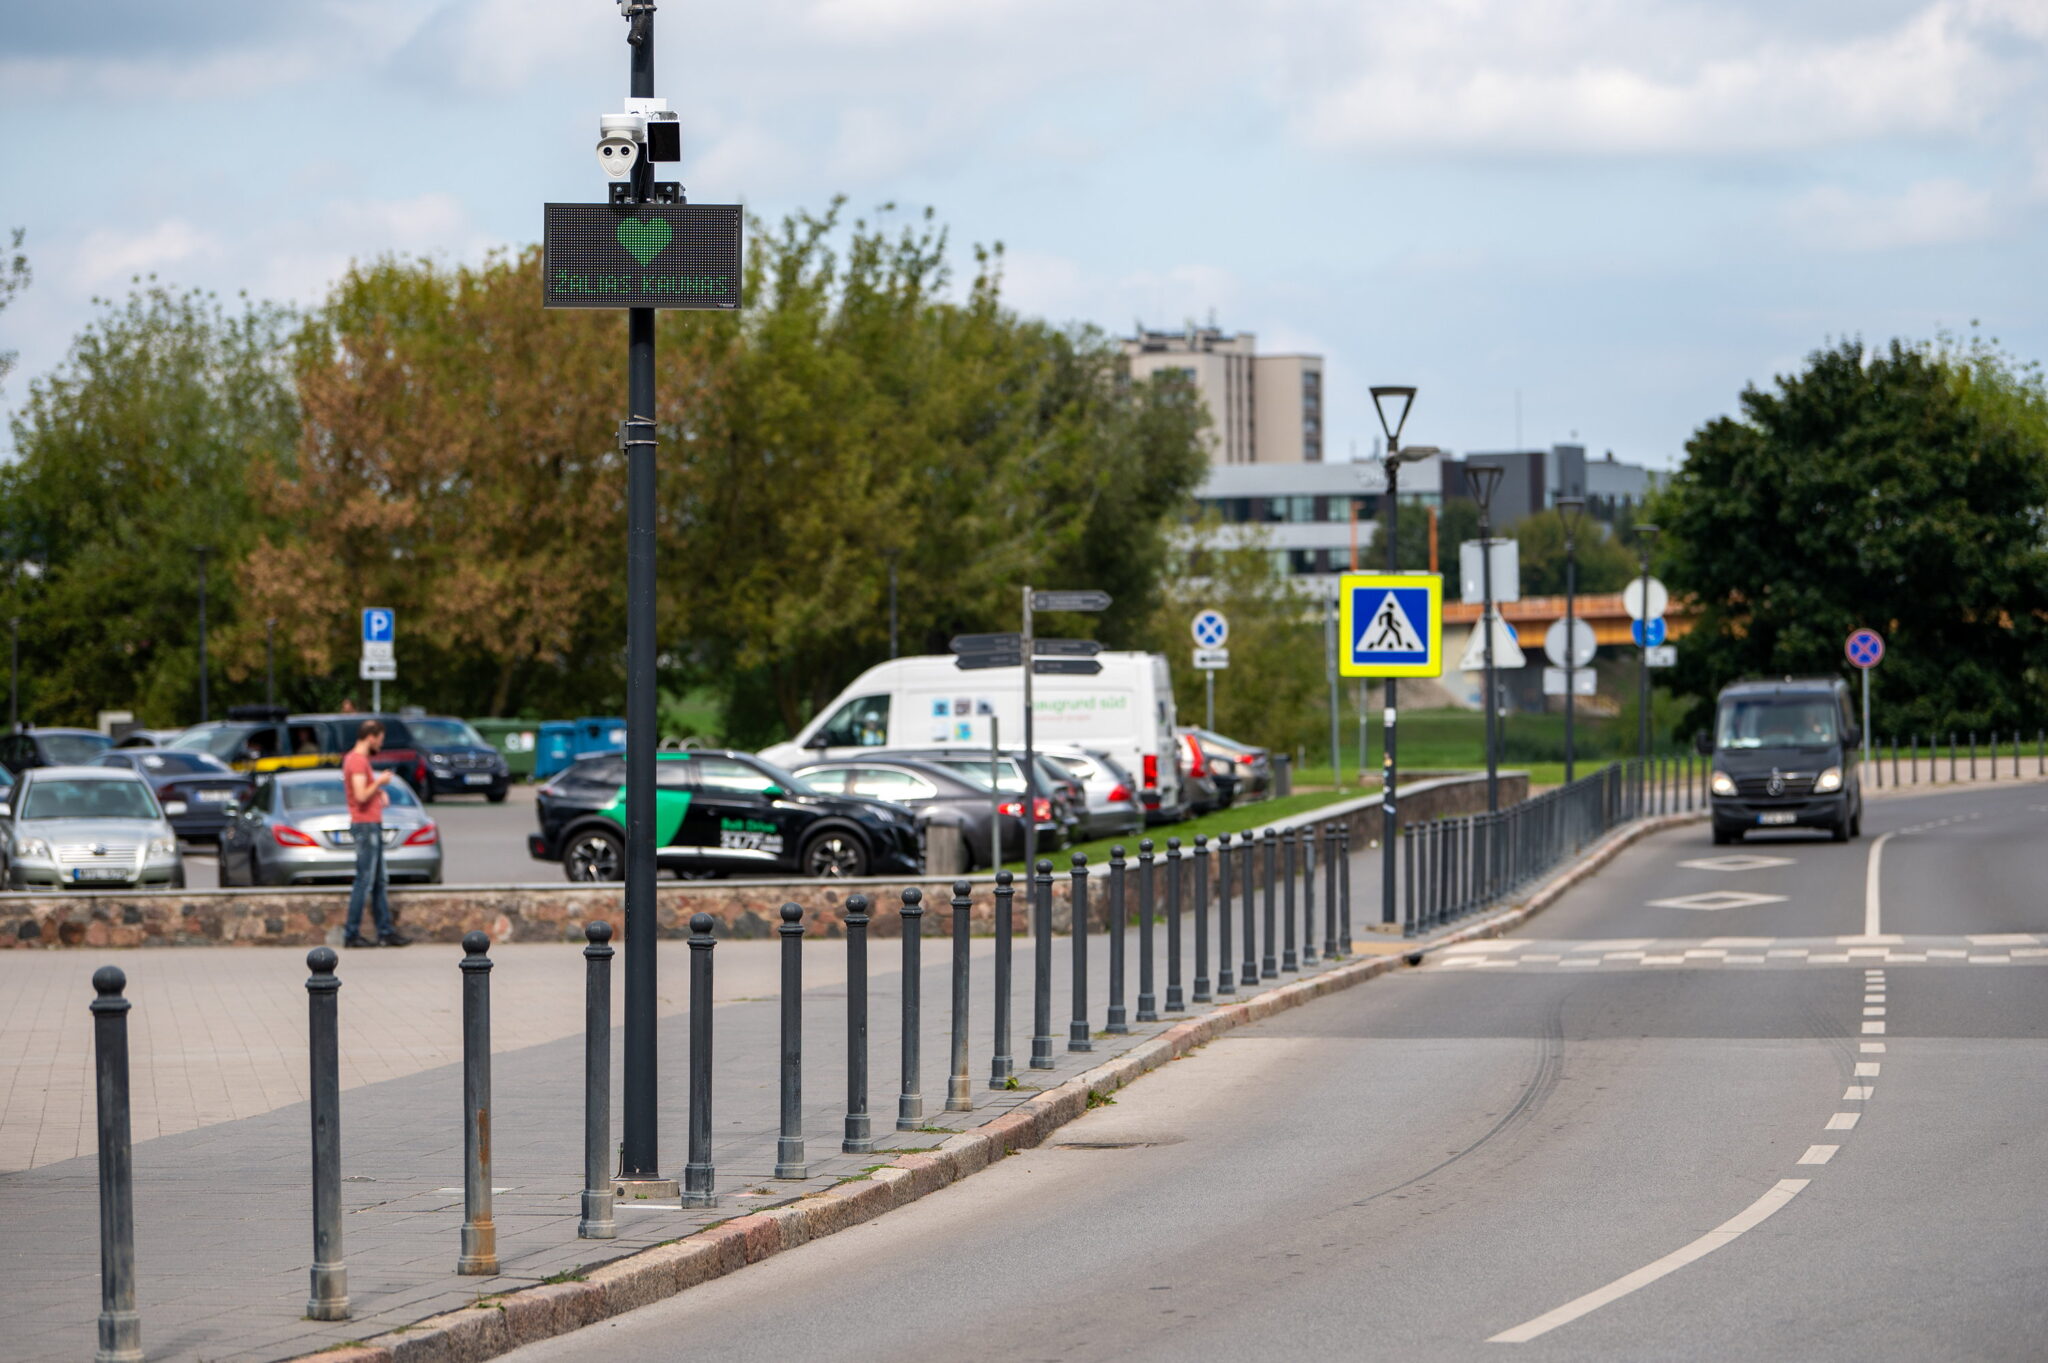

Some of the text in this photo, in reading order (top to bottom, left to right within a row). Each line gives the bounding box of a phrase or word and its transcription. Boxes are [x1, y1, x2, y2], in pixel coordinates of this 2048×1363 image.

[555, 269, 729, 294] ŽALIAS KAUNAS
[371, 611, 389, 640] P
[1029, 697, 1096, 714] augrund
